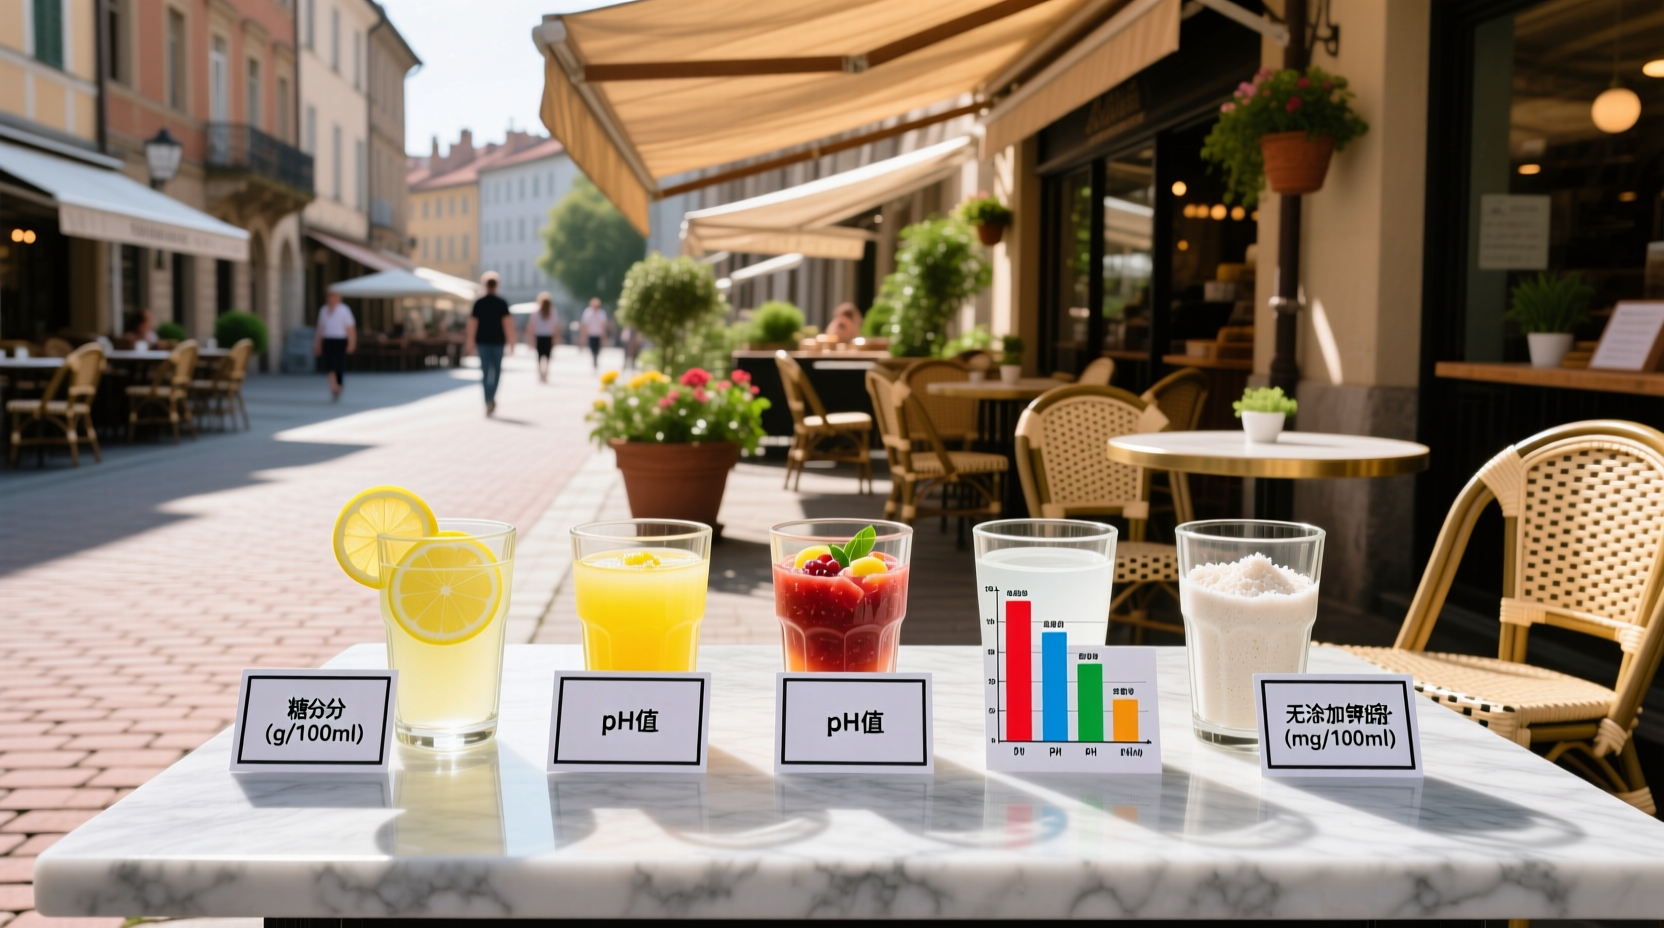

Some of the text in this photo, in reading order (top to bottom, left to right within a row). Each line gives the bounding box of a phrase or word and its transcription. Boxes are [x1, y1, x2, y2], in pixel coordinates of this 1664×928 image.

[265, 723, 364, 746] (g/100ml)
[602, 709, 659, 736] pH值
[827, 710, 885, 737] pH值
[1285, 728, 1396, 751] (mg/100ml)
